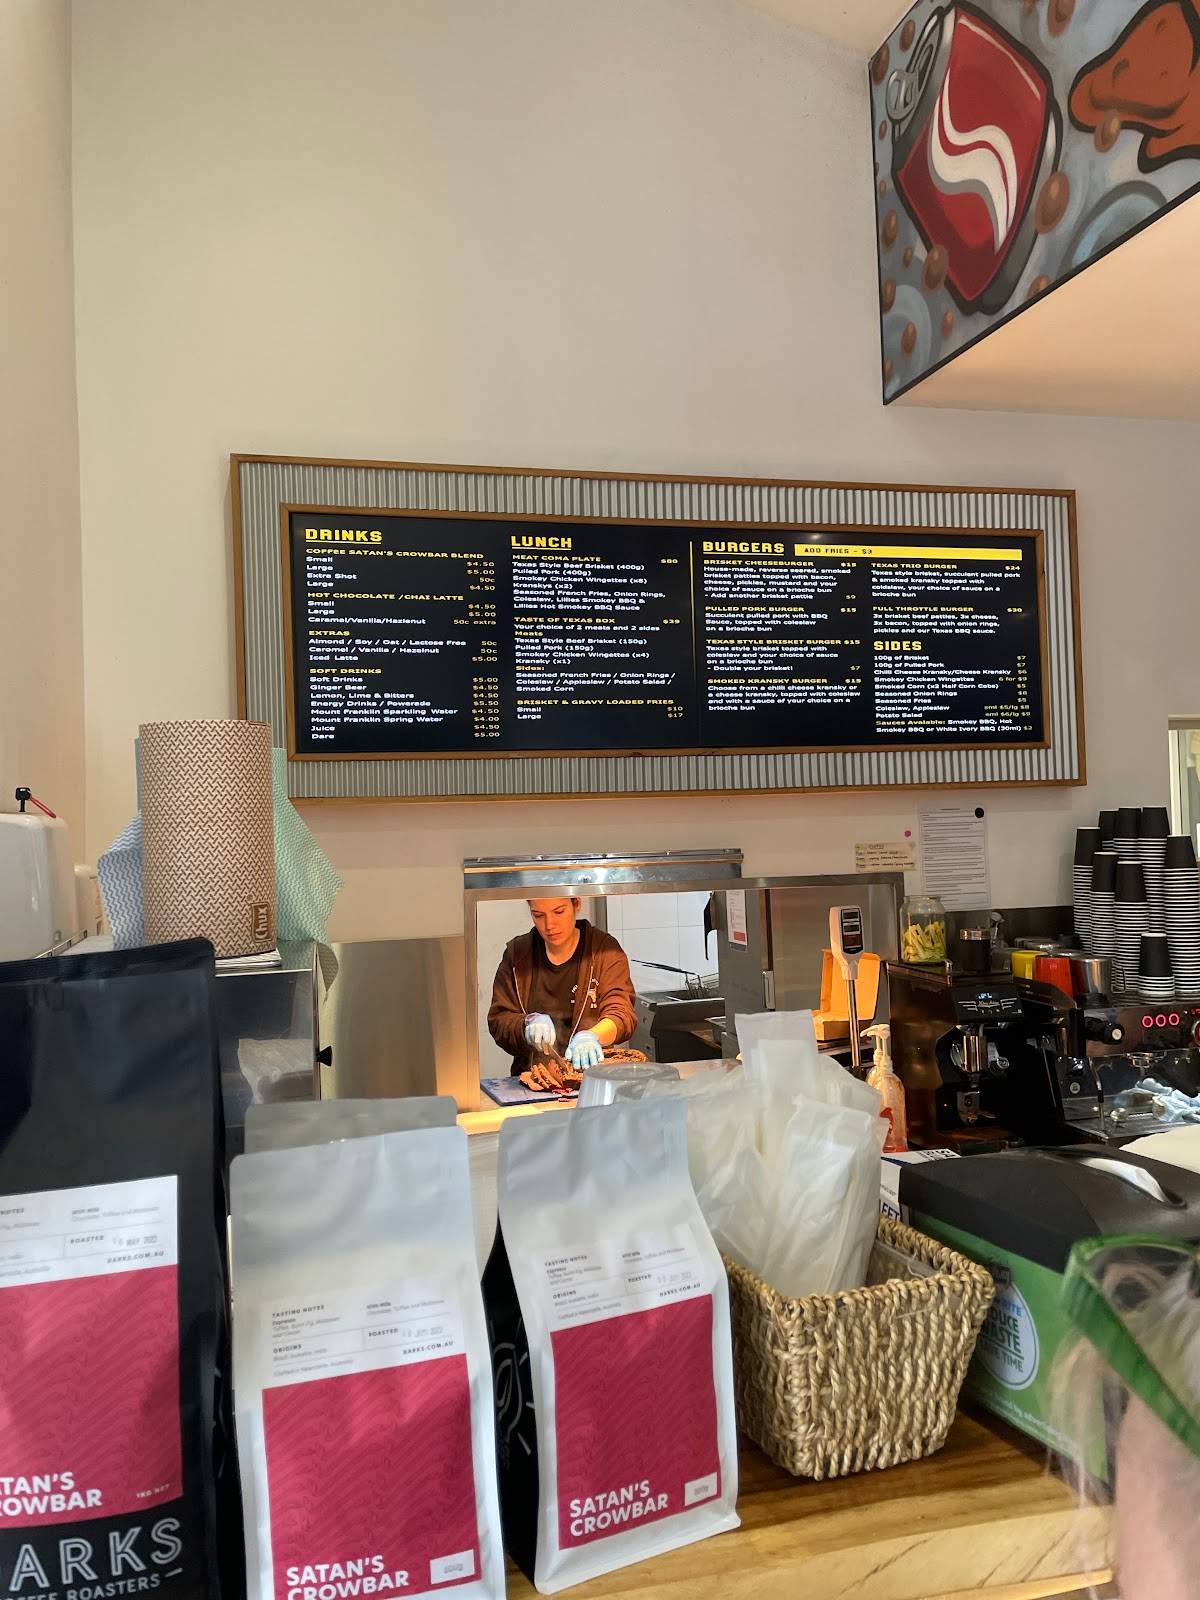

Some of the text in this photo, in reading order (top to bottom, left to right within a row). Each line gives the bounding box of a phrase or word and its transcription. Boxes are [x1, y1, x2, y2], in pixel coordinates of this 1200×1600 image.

[306, 529, 382, 542] DRINKS
[511, 536, 572, 549] LUNCH
[703, 542, 784, 554] BURGERS
[874, 641, 921, 650] SIDES
[70, 1235, 104, 1244] ROASTED
[544, 1255, 587, 1267] TASTING NOTES
[553, 1290, 577, 1300] ORIGINS
[272, 1304, 325, 1318] TASTING NOTES
[368, 1328, 399, 1337] ROASTED
[273, 1343, 302, 1354] ORIGINS
[0, 1472, 74, 1496] TAN'S
[0, 1489, 103, 1516] OWBAR
[570, 1480, 650, 1518] SATAN'S
[570, 1493, 668, 1537] CROWBAR
[8, 1517, 183, 1592] ARKS
[286, 1554, 385, 1586] SATAN'S
[67, 1573, 160, 1600] ROASTERS
[287, 1570, 409, 1600] CROWBAR
